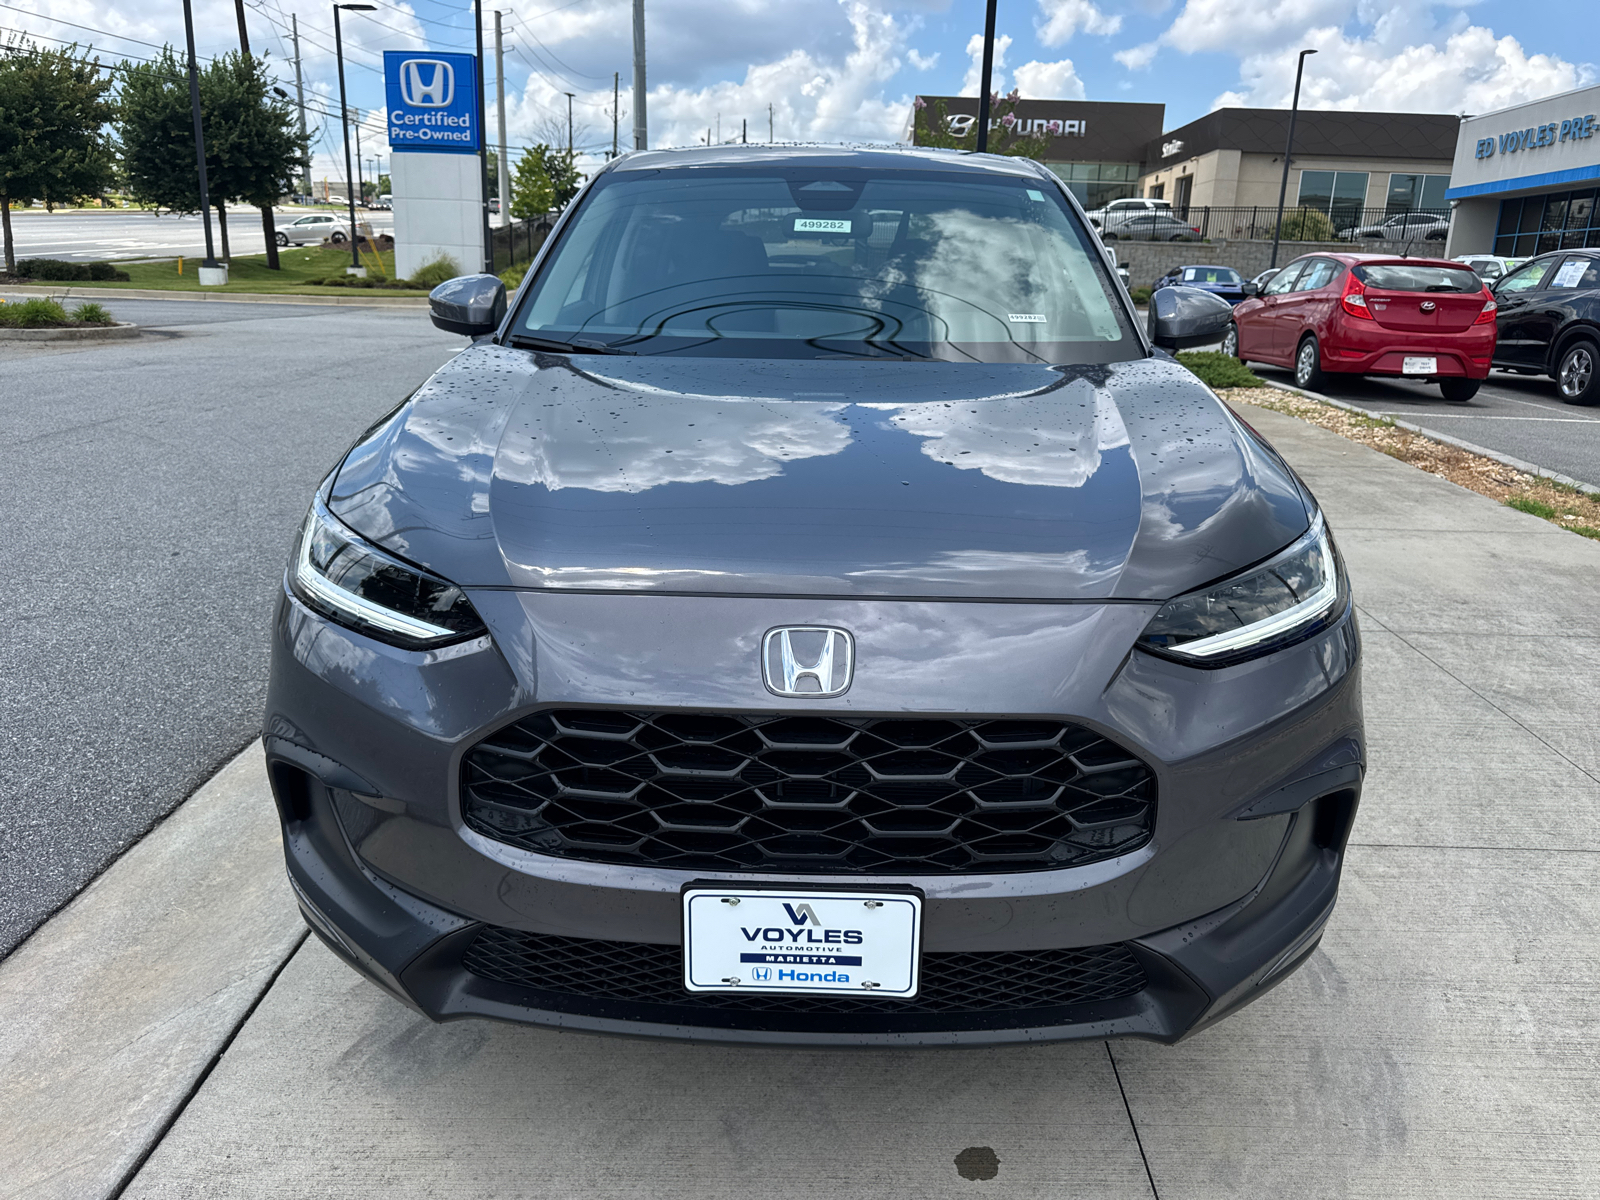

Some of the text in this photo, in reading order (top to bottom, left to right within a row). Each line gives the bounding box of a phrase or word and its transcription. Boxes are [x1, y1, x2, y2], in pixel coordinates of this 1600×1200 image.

[391, 110, 470, 127] Certified
[391, 127, 471, 141] Pre-Owned
[1475, 137, 1496, 160] ED
[1498, 122, 1559, 155] VOYLES
[800, 220, 844, 229] 499282
[740, 927, 863, 944] VOYLES
[760, 945, 843, 953] AUTOMOTIVE
[765, 955, 837, 964] MARIETTA
[778, 969, 850, 983] Honda
